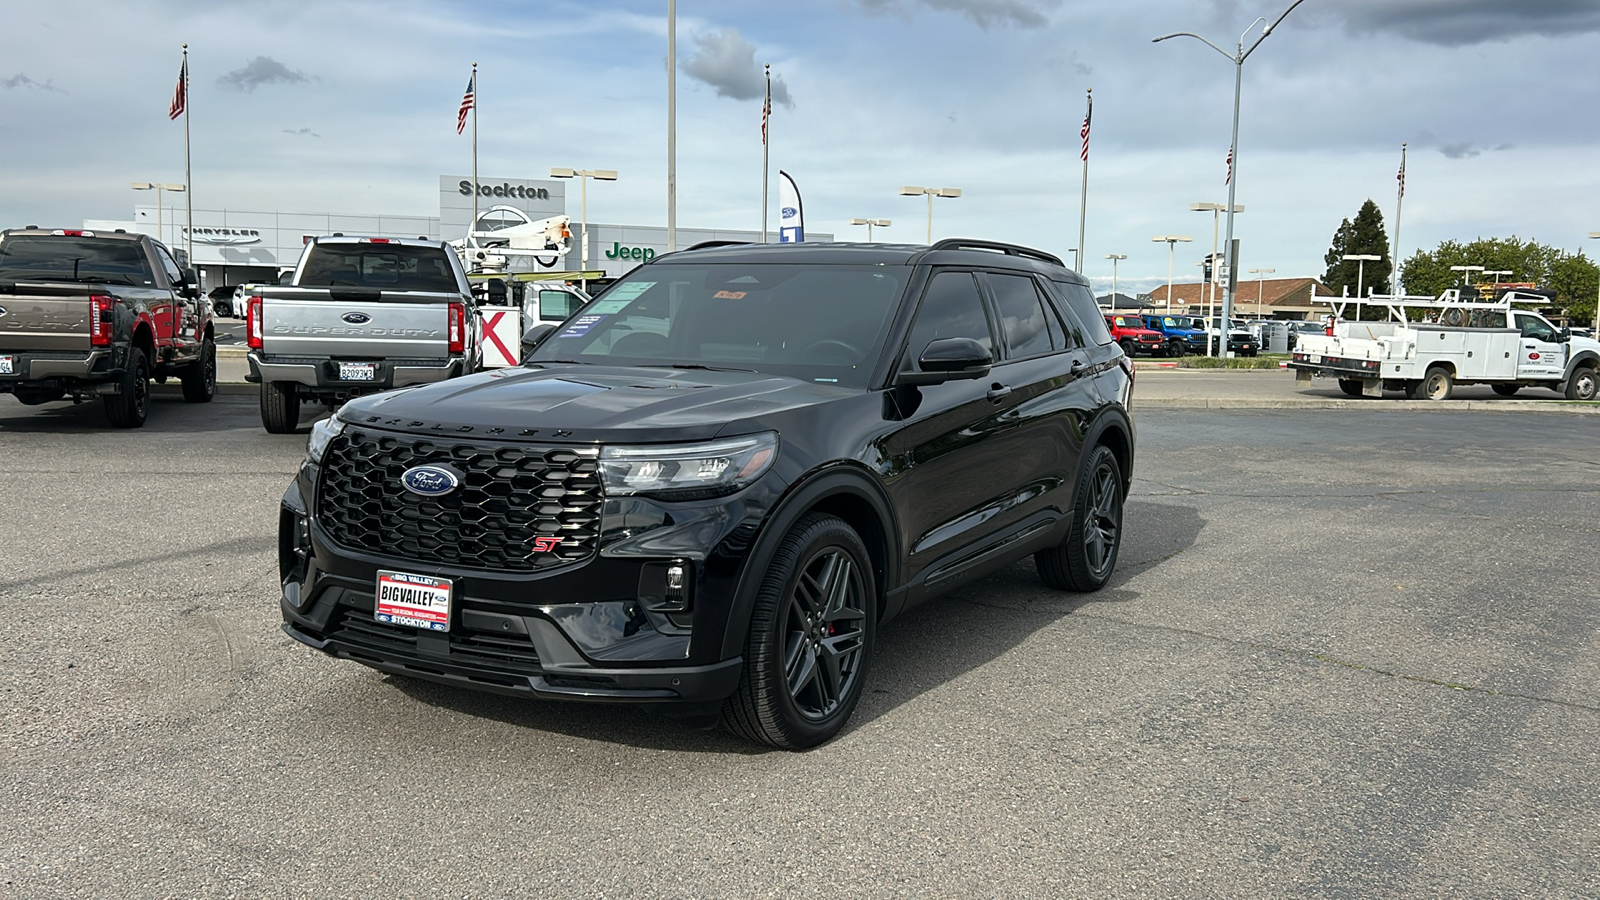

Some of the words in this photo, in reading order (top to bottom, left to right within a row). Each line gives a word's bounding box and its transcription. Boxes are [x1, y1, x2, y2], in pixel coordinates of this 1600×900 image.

[458, 180, 548, 199] Stockton
[182, 228, 259, 237] CHRYSLER
[605, 242, 654, 262] Jeep
[6, 321, 79, 330] DUTY
[273, 325, 364, 335] SUPER
[366, 327, 439, 337] DUTY
[366, 415, 573, 438] EXPLORER
[532, 536, 565, 552] ST
[394, 574, 407, 582] BIG
[408, 576, 434, 585] VALLEY
[391, 615, 432, 629] STOCKTON
